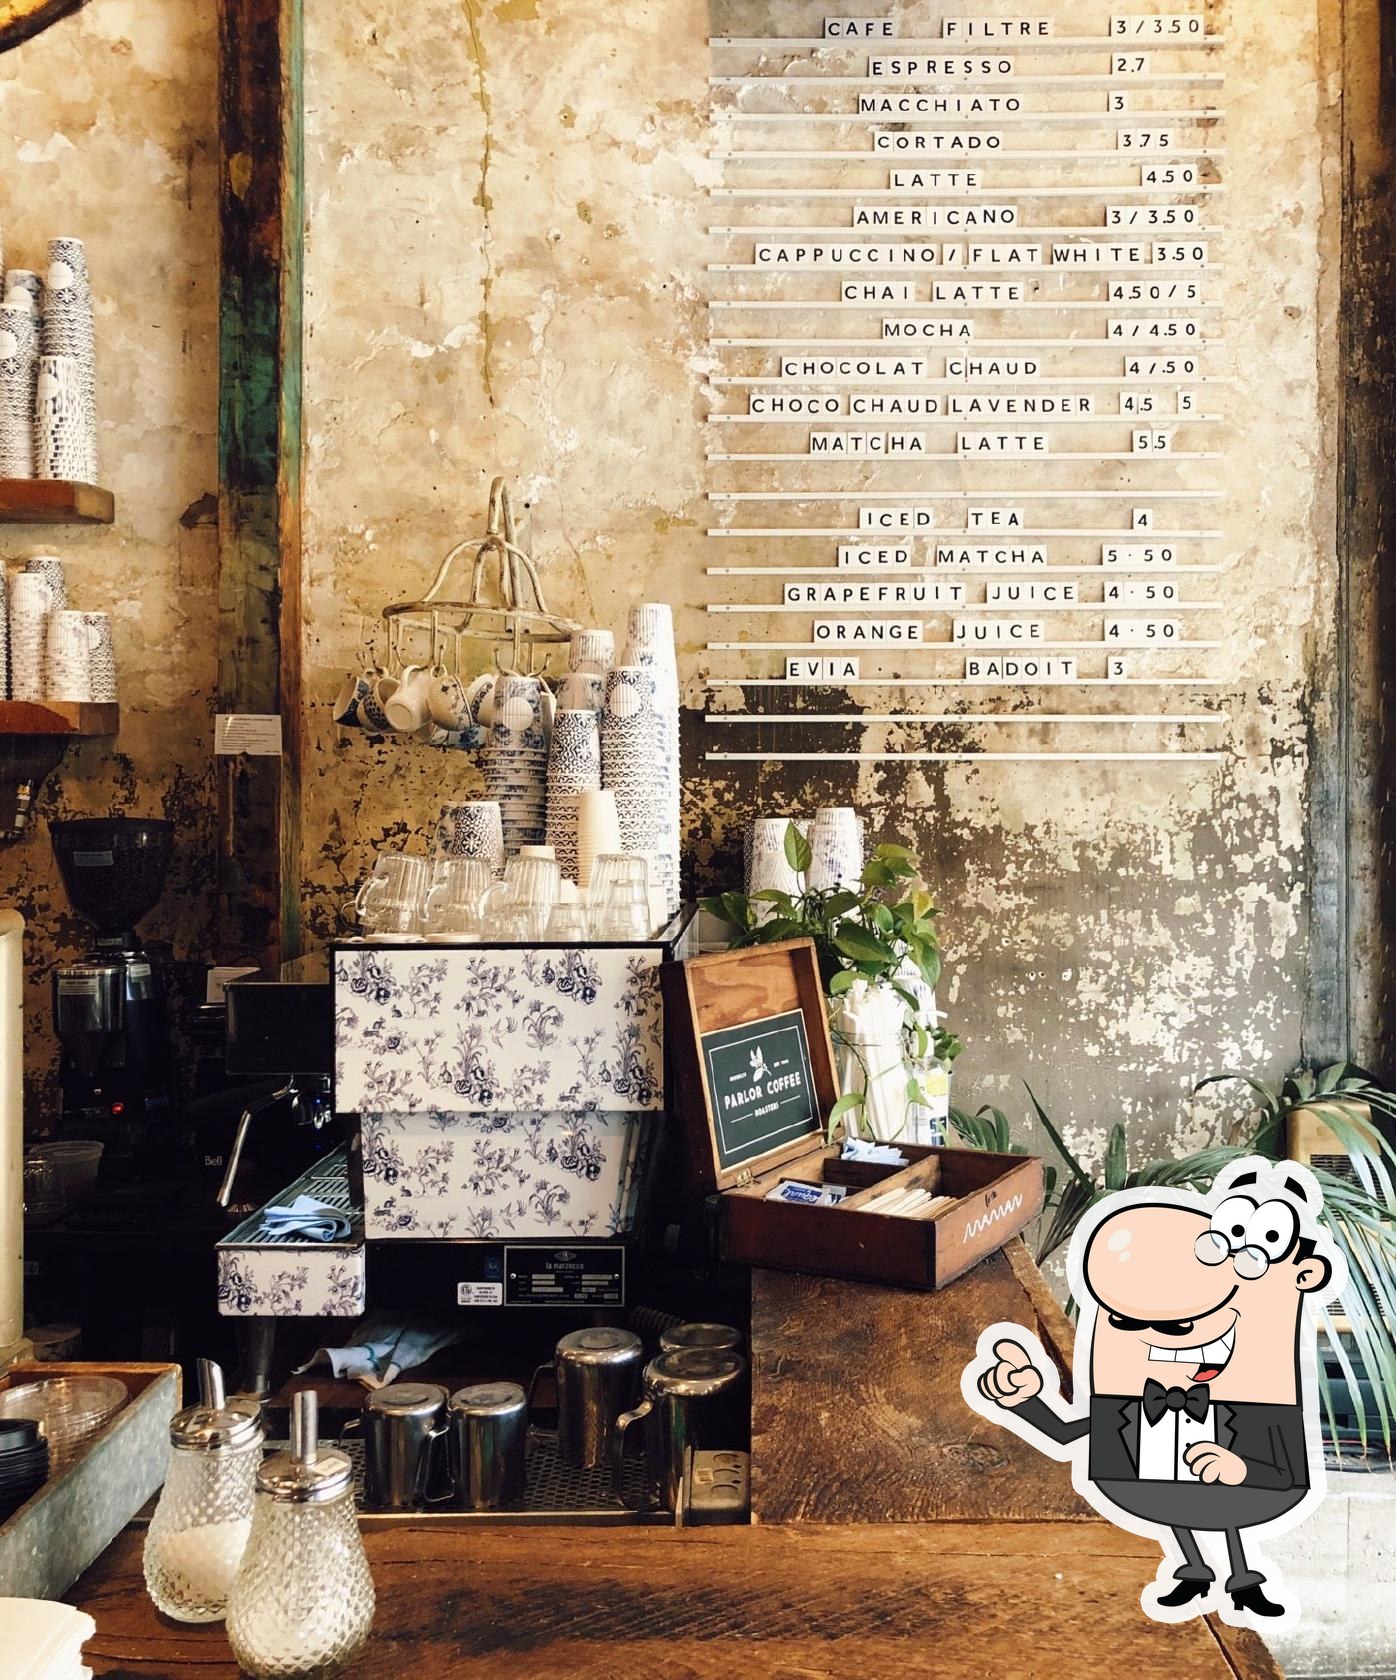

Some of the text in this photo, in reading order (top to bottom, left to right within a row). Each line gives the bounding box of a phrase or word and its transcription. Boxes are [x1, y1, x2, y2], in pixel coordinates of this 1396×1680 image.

[827, 21, 895, 37] CAFE
[946, 21, 1050, 36] FILTRE
[872, 57, 1146, 77] ESPRESSO 2.7
[860, 95, 1125, 113] MACCHIATO 3
[877, 133, 1170, 149] CORTADO 3.75
[893, 169, 1194, 188] LATTE 4.50
[856, 209, 1016, 226] AMERICANO
[1053, 247, 1141, 263] WHITE
[1156, 246, 1204, 262] 3.50
[843, 285, 910, 301] CHAI
[935, 286, 1020, 301] LATTE
[884, 322, 971, 337] MOCHA
[784, 361, 924, 376] CHOCOLAT
[948, 360, 1038, 376] CHAUD
[751, 395, 1192, 415] CHOCO CHAUD LAVENDER 4.5 5
[811, 434, 1167, 452] MATCHA LATTE 5.5
[866, 511, 1149, 528] ICED TEA 4
[844, 548, 909, 564] ICED
[938, 549, 1045, 564] MATCHA
[787, 586, 963, 602] GRAPEFRUIT
[991, 585, 1076, 601] JUICE
[816, 624, 920, 640] ORANGE
[956, 623, 1041, 640] JUICE
[789, 660, 1124, 677] EVIA BADOIT 3
[724, 1085, 763, 1110] PARLOR
[766, 1071, 801, 1095] COFFEE
